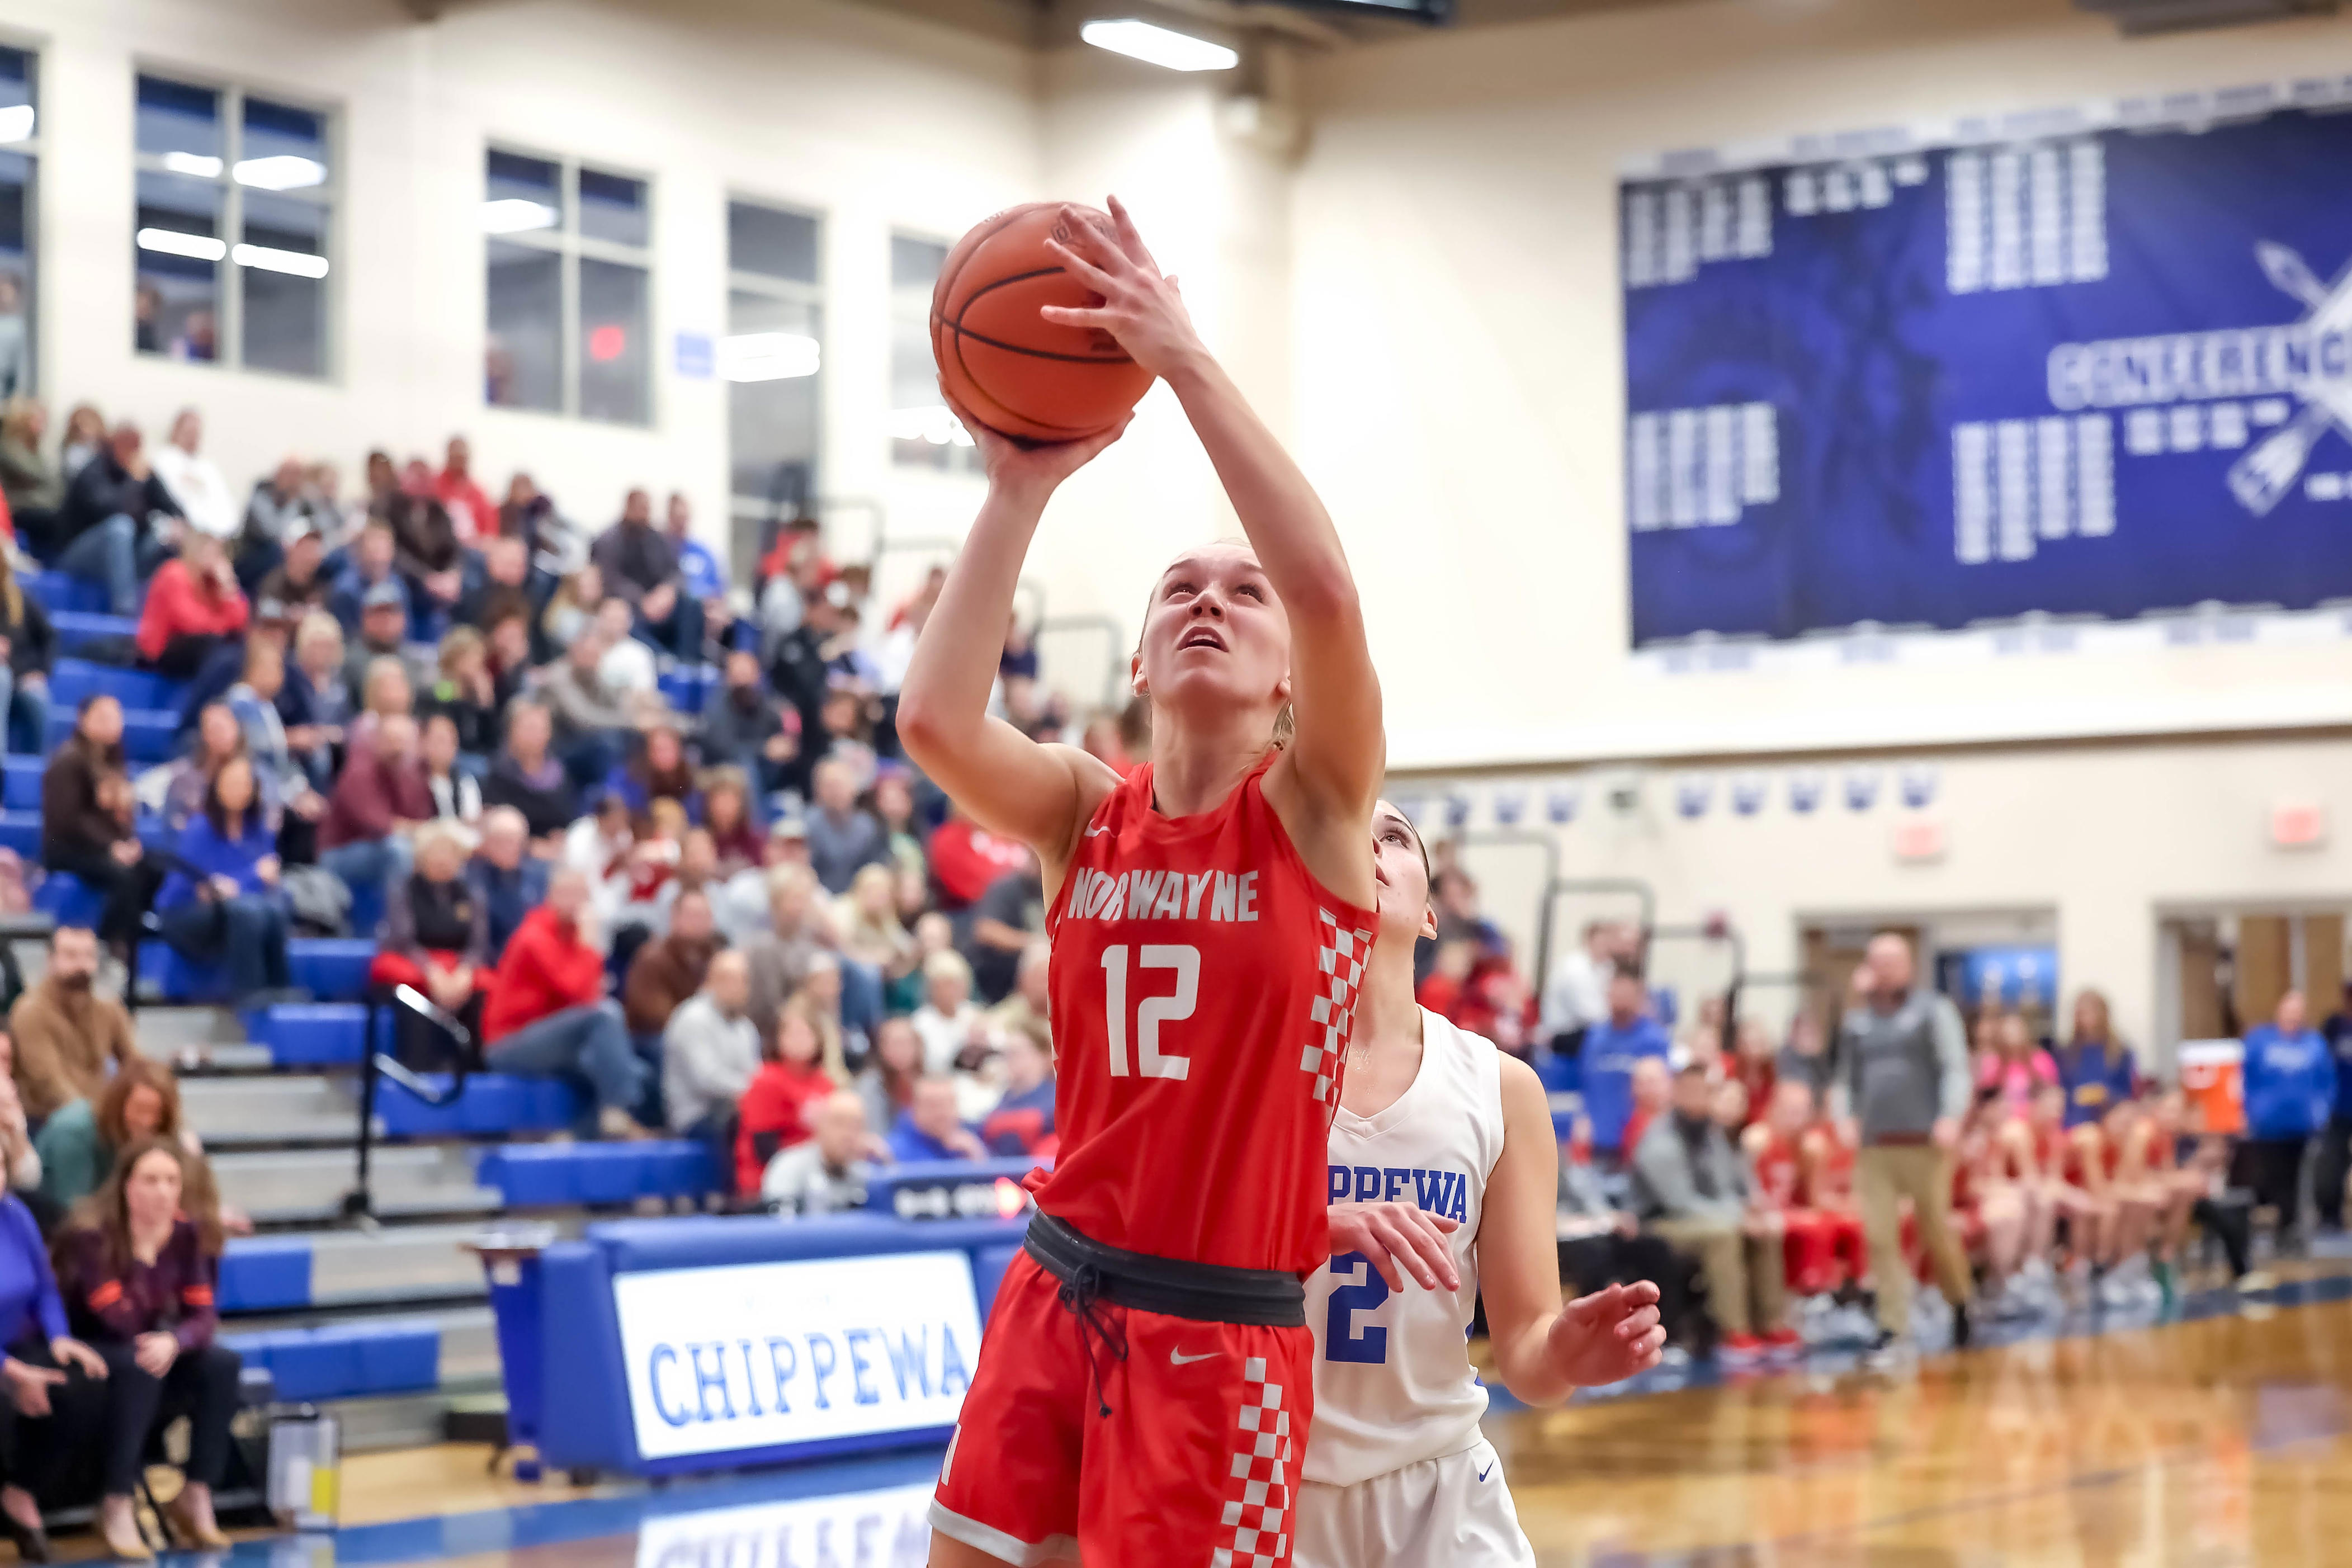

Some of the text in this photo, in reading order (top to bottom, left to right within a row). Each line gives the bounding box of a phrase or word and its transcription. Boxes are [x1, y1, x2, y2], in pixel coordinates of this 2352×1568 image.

[1068, 867, 1259, 922] NORWAYNE
[1101, 944, 1201, 1080] 12
[1325, 1250, 1390, 1364] 2
[649, 1321, 971, 1428] CHIPPEWA
